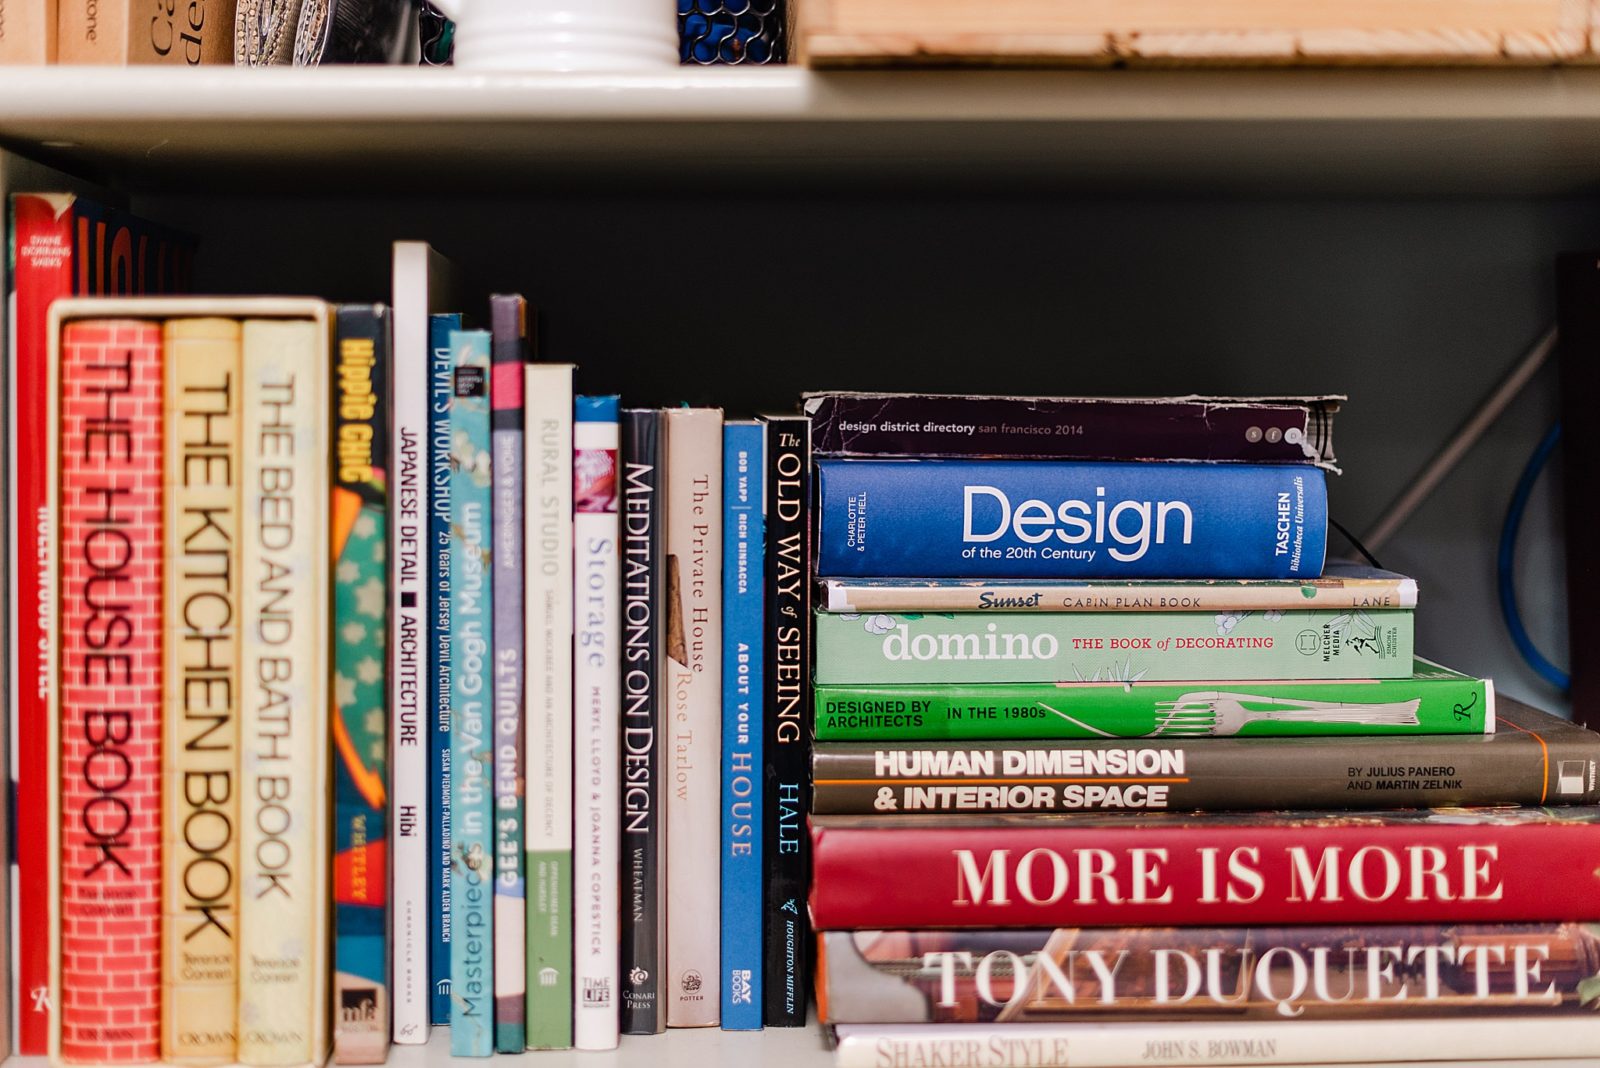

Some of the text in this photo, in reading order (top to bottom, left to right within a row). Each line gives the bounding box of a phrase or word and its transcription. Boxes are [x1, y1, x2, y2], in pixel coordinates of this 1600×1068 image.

[84, 350, 133, 464] THE
[433, 347, 450, 523] DEVILS WORKSHOP
[838, 422, 1084, 435] design district directory san francisco 2014
[541, 419, 560, 576] RURAL STUDIO
[738, 451, 748, 594] BOB YAPP RICH BINSACCA
[847, 496, 856, 547] CHARLOTTE
[858, 491, 867, 515] FIELL
[962, 485, 1193, 562] Design
[1275, 492, 1290, 556] TASCHEN
[1290, 476, 1305, 572] Bibliotheca Universalis
[438, 531, 450, 545] 25
[857, 517, 866, 544] PETER
[962, 547, 1096, 562] of the 20th Century
[82, 485, 134, 686] HOUSE
[400, 427, 418, 746] JAPANESE DETAIL ARCHITECTURE
[438, 549, 450, 577] Years
[691, 474, 709, 674] The Private House
[775, 433, 801, 743] The OLD WAY of SEEING
[436, 595, 450, 631] Jersey
[581, 537, 613, 669] Storage
[978, 591, 1043, 609] Sunset
[1115, 597, 1153, 607] PLAN
[1160, 597, 1201, 607] BOOK
[1353, 597, 1390, 606] LANE
[183, 371, 233, 943] THE KITCHEN BOOK
[256, 374, 295, 900] THE BED AND BATH BOOK
[438, 634, 450, 662] Devil
[624, 462, 654, 833] MEDITATIONS ON DESIGN
[882, 622, 1274, 661] domino THE BOOK of DECORATING
[1323, 624, 1331, 662] MELCHER
[438, 665, 450, 732] Architecture
[826, 701, 931, 714] DESIGNED BY
[827, 715, 923, 728] ARCHITECTS
[947, 707, 1046, 719] IN THE 1980s
[458, 501, 487, 1018] Masterpieces in the Van Gogh Museum
[498, 648, 519, 887] GEE'S BEND QUILTS
[545, 712, 554, 778] ARCHITECTURE
[590, 738, 601, 786] LLOYD
[675, 672, 693, 801] Rose Tarlow
[731, 642, 752, 857] ABOUT YOUR HOUSE
[874, 749, 1185, 776] HUMAN DIMENSION
[82, 710, 134, 878] BOOK
[591, 792, 601, 801] &
[874, 785, 1169, 810] & INTERIOR SPACE
[1347, 779, 1463, 790] AND MARTIN ZELNIK
[1348, 766, 1455, 777] BY JULIUS PANERO
[400, 805, 417, 837] Hibi
[442, 748, 450, 942] SUSAN PIEDMONT-PALLADINO AND MARK ALDEN BRANCH
[589, 806, 602, 867] JOANNA
[778, 782, 799, 855] HALE
[351, 815, 367, 900] WHITLEY
[631, 848, 644, 923] WHEATMAN
[951, 845, 1503, 907] MORE IS MORE
[590, 872, 602, 956] COPESTICK
[583, 977, 610, 987] TIME
[583, 988, 610, 1002] LIFE
[732, 969, 742, 1004] BOOKS
[742, 969, 752, 1004] BAY
[786, 920, 794, 1014] HOUGHTON MIFFLIN
[923, 943, 1556, 1017] TONY DUQUETTE
[875, 1035, 1070, 1068] SHAKER STYLE
[1142, 1040, 1184, 1060] JOHN
[1207, 1038, 1277, 1059] BOWMAN
